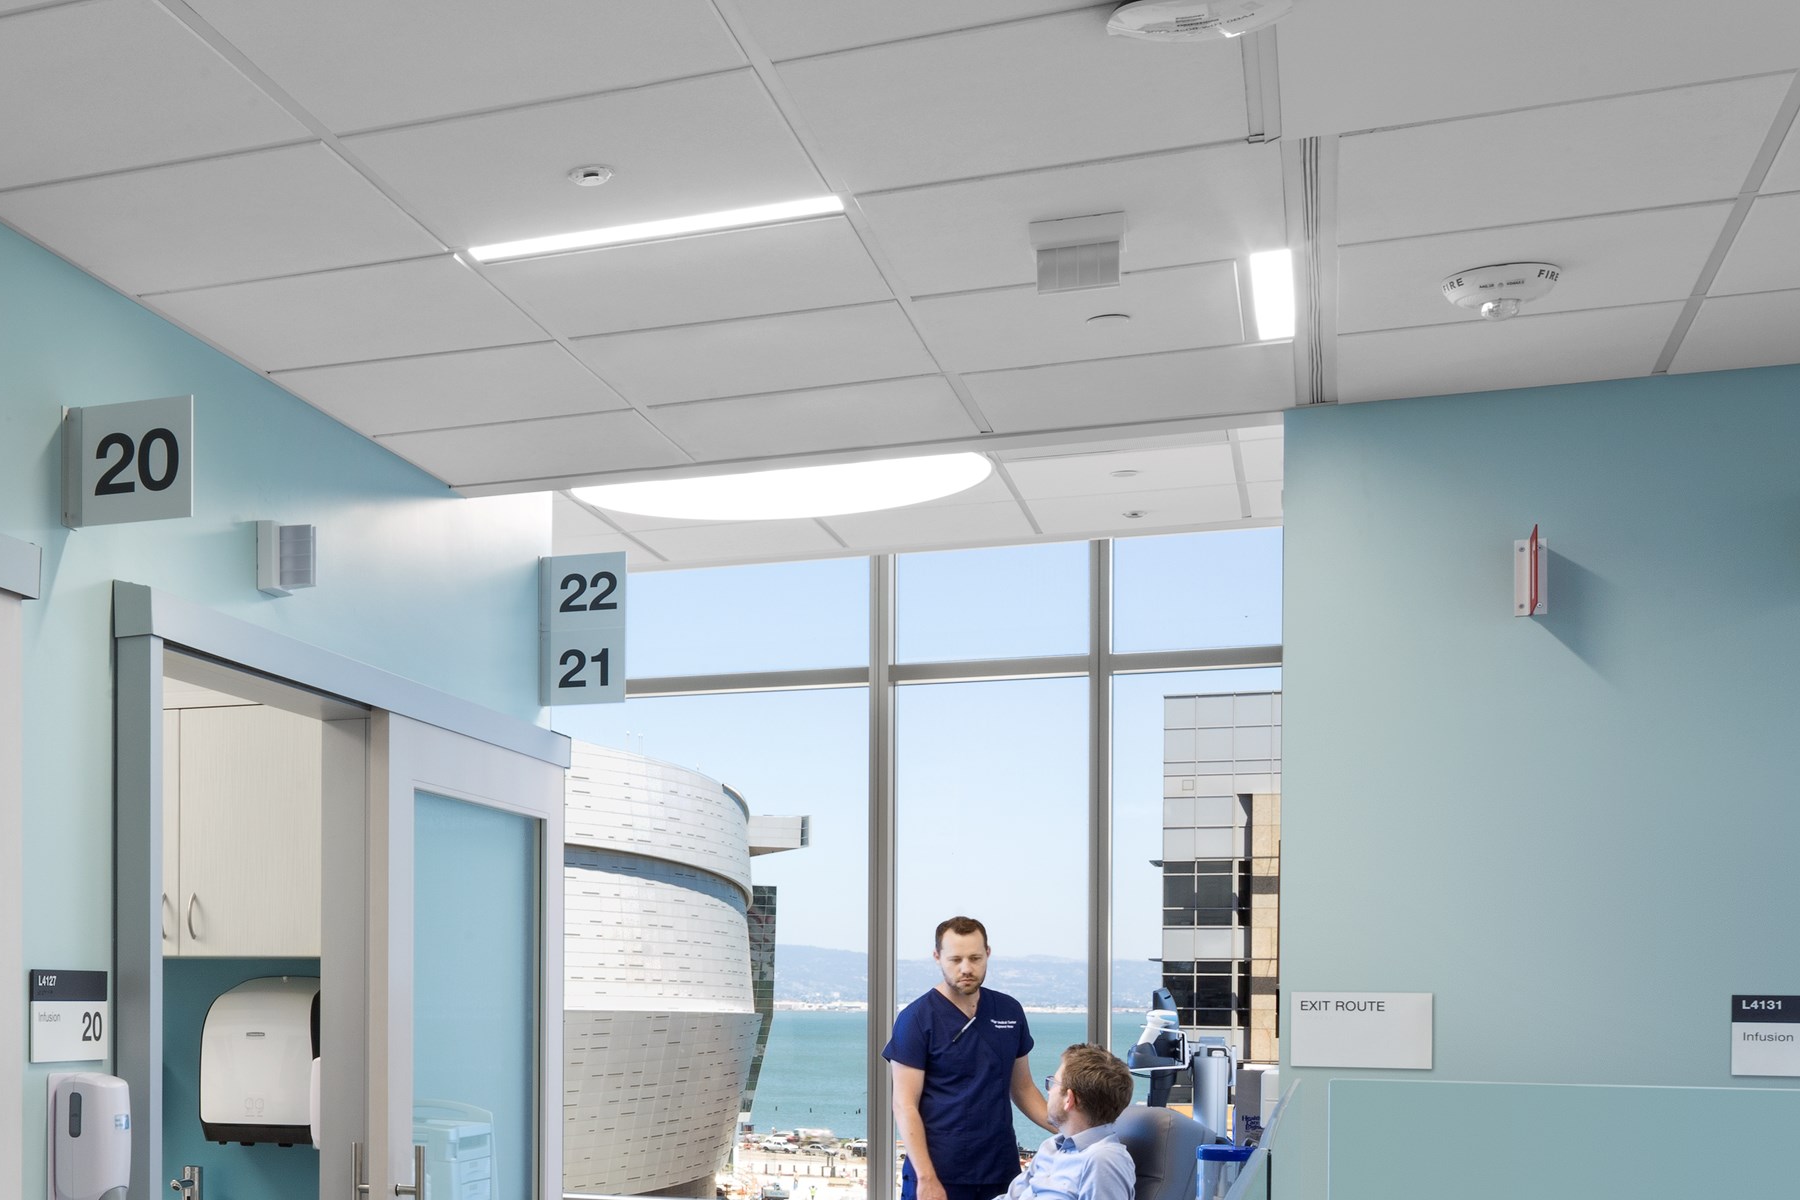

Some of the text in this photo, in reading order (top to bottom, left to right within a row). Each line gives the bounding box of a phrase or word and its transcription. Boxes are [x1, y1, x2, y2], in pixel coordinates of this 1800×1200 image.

[1537, 269, 1560, 282] FIRE
[1442, 278, 1464, 293] FIRE
[94, 427, 179, 496] 20
[559, 571, 617, 613] 22
[558, 648, 609, 688] 21
[38, 975, 57, 986] L4127
[1300, 1000, 1385, 1012] EXIT ROUTE
[1742, 1000, 1782, 1010] L4131
[38, 1011, 61, 1022] Infusion
[82, 1011, 102, 1042] 20
[1743, 1032, 1794, 1042] Infusion
